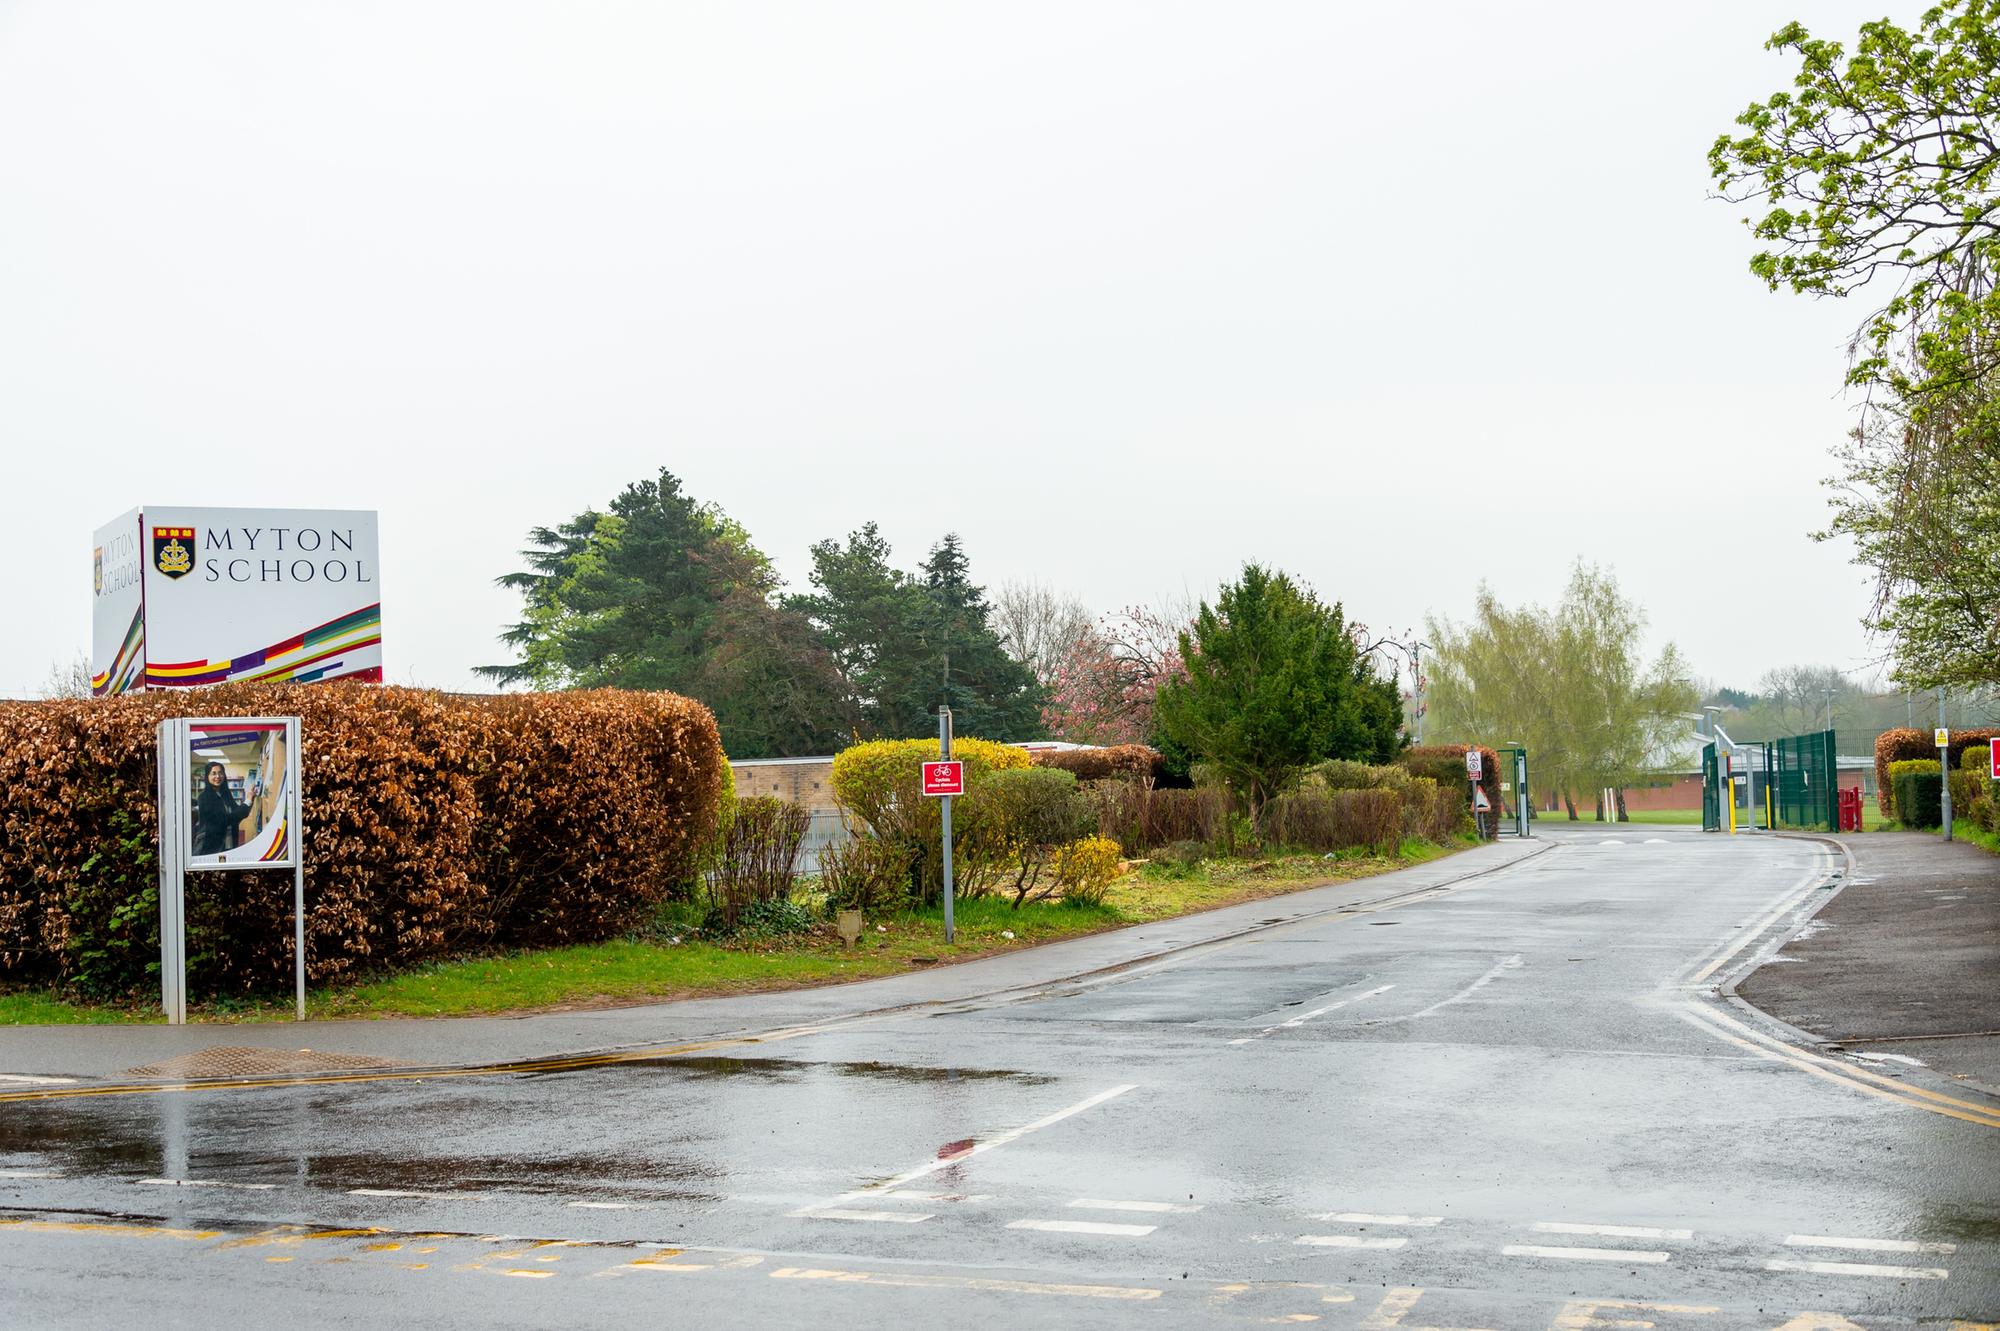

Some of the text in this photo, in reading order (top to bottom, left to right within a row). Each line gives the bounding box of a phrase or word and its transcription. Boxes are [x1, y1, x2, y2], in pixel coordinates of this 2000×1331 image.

[205, 527, 353, 551] MYTON
[103, 560, 139, 596] SCHOOL
[205, 558, 371, 582] SCHOOL
